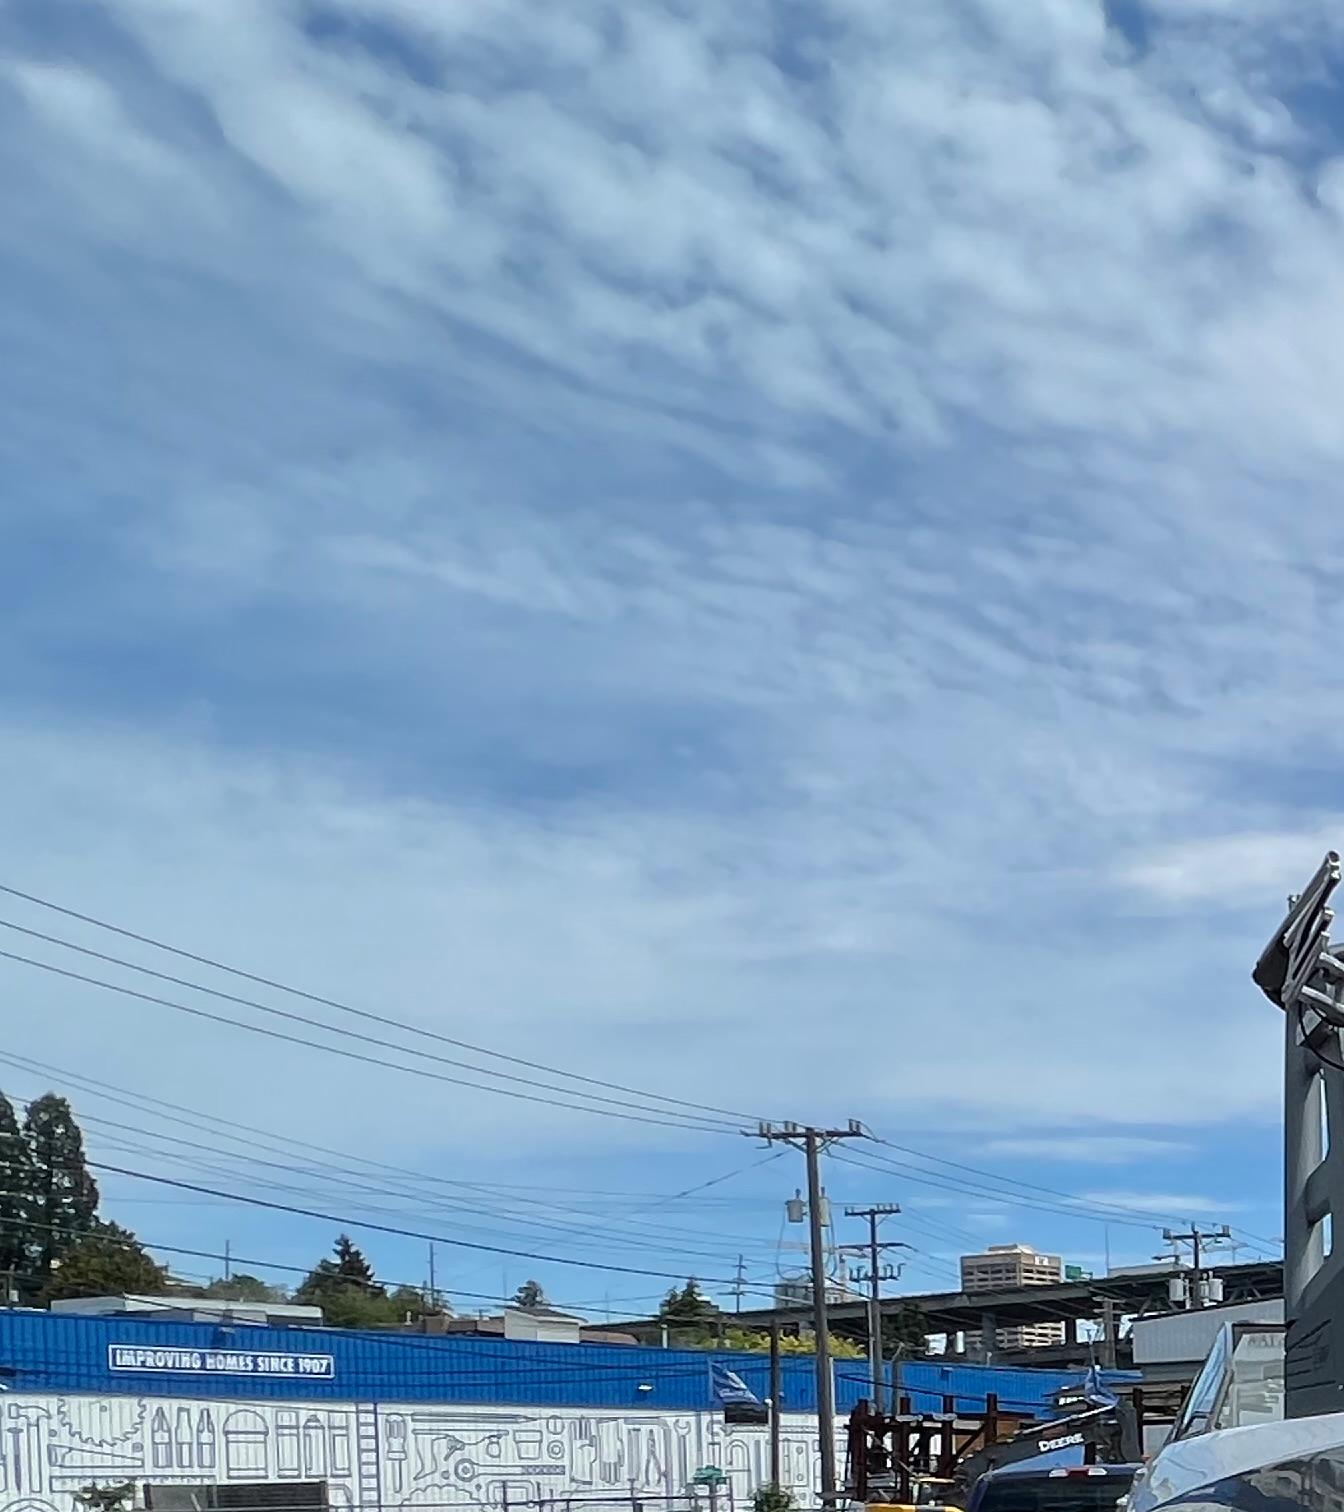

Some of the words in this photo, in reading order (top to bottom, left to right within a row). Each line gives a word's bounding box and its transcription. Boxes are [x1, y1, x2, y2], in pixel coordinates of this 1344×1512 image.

[116, 1349, 201, 1369] IMPROVING
[206, 1353, 254, 1371] HOMES
[256, 1356, 295, 1372] SINCE
[298, 1359, 328, 1374] 1907
[1038, 1432, 1085, 1452] DEERE
